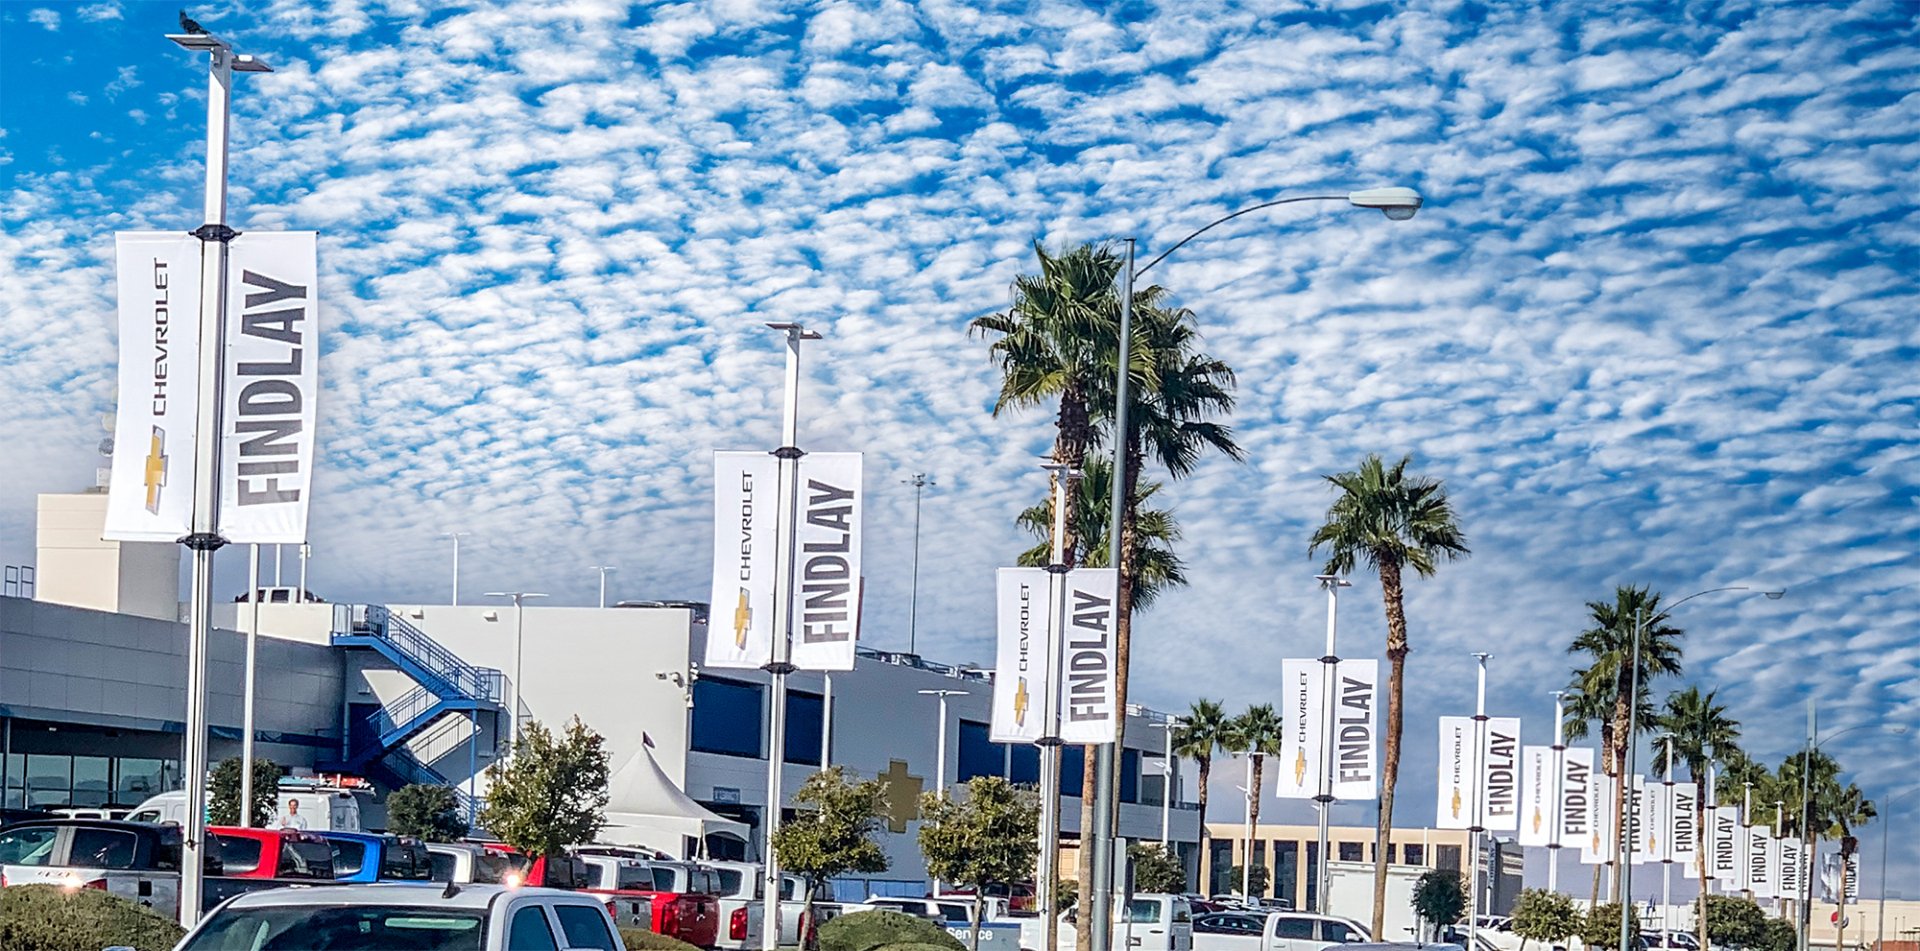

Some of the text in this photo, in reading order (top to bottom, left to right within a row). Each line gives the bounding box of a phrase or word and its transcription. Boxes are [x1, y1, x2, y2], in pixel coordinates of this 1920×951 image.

[152, 256, 169, 417] CHEVROLET
[235, 268, 308, 507] FINDLAY
[740, 469, 753, 582] CHEVROLET
[802, 478, 855, 644] FINDLAY
[1019, 582, 1030, 672] CHEVROLET
[1069, 589, 1112, 723] FINDLAY
[1298, 670, 1308, 743] CHEVROLET
[1338, 675, 1373, 784] FINDLAY
[1453, 726, 1462, 784] CHEVROLET
[1487, 731, 1516, 817] FINDLAY
[1564, 760, 1590, 835] FINDLAY
[1674, 793, 1694, 853] FINDLAY
[1716, 816, 1734, 870] FINDLAY
[1751, 833, 1768, 883] FINDLAY
[1782, 844, 1798, 891] FINDLAY
[946, 927, 993, 941] Serce
